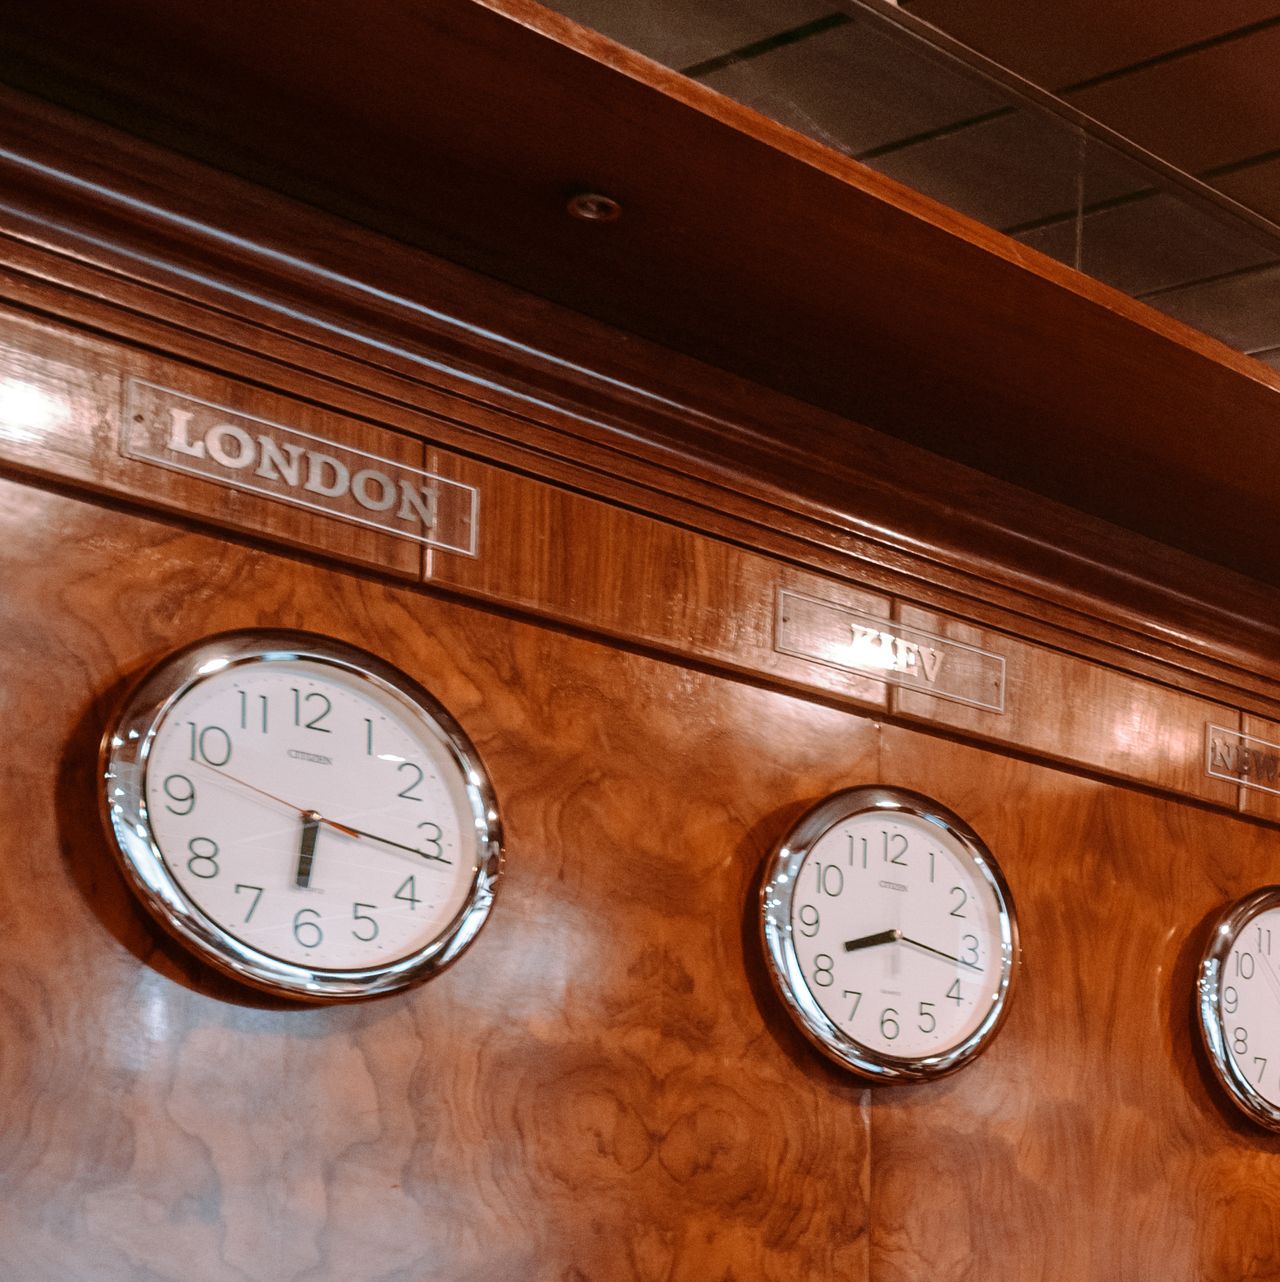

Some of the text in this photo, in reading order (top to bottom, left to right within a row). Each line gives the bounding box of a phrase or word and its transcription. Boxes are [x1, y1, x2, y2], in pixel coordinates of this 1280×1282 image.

[166, 407, 438, 528] LONDON
[238, 690, 268, 734] 11
[291, 687, 332, 733] 12
[188, 722, 232, 766] 10
[364, 718, 373, 755] 1
[163, 774, 195, 815] 9
[397, 763, 424, 801] 2
[187, 837, 219, 878] 8
[416, 822, 443, 859] 3
[847, 835, 867, 869] 11
[881, 830, 908, 866] 12
[815, 862, 843, 897] 10
[928, 852, 935, 883] 1
[234, 884, 264, 923] 7
[393, 875, 422, 910] 4
[949, 886, 967, 918] 2
[292, 909, 323, 948] 6
[352, 902, 379, 942] 5
[800, 904, 820, 937] 9
[961, 934, 980, 966] 3
[1257, 927, 1271, 956] 11
[813, 954, 835, 987] 8
[1234, 950, 1255, 980] 10
[843, 990, 862, 1021] 7
[945, 978, 965, 1007] 4
[1224, 986, 1238, 1014] 9
[880, 1008, 900, 1040] 6
[917, 1002, 936, 1033] 5
[1233, 1026, 1248, 1054] 8
[1253, 1057, 1267, 1084] 7
